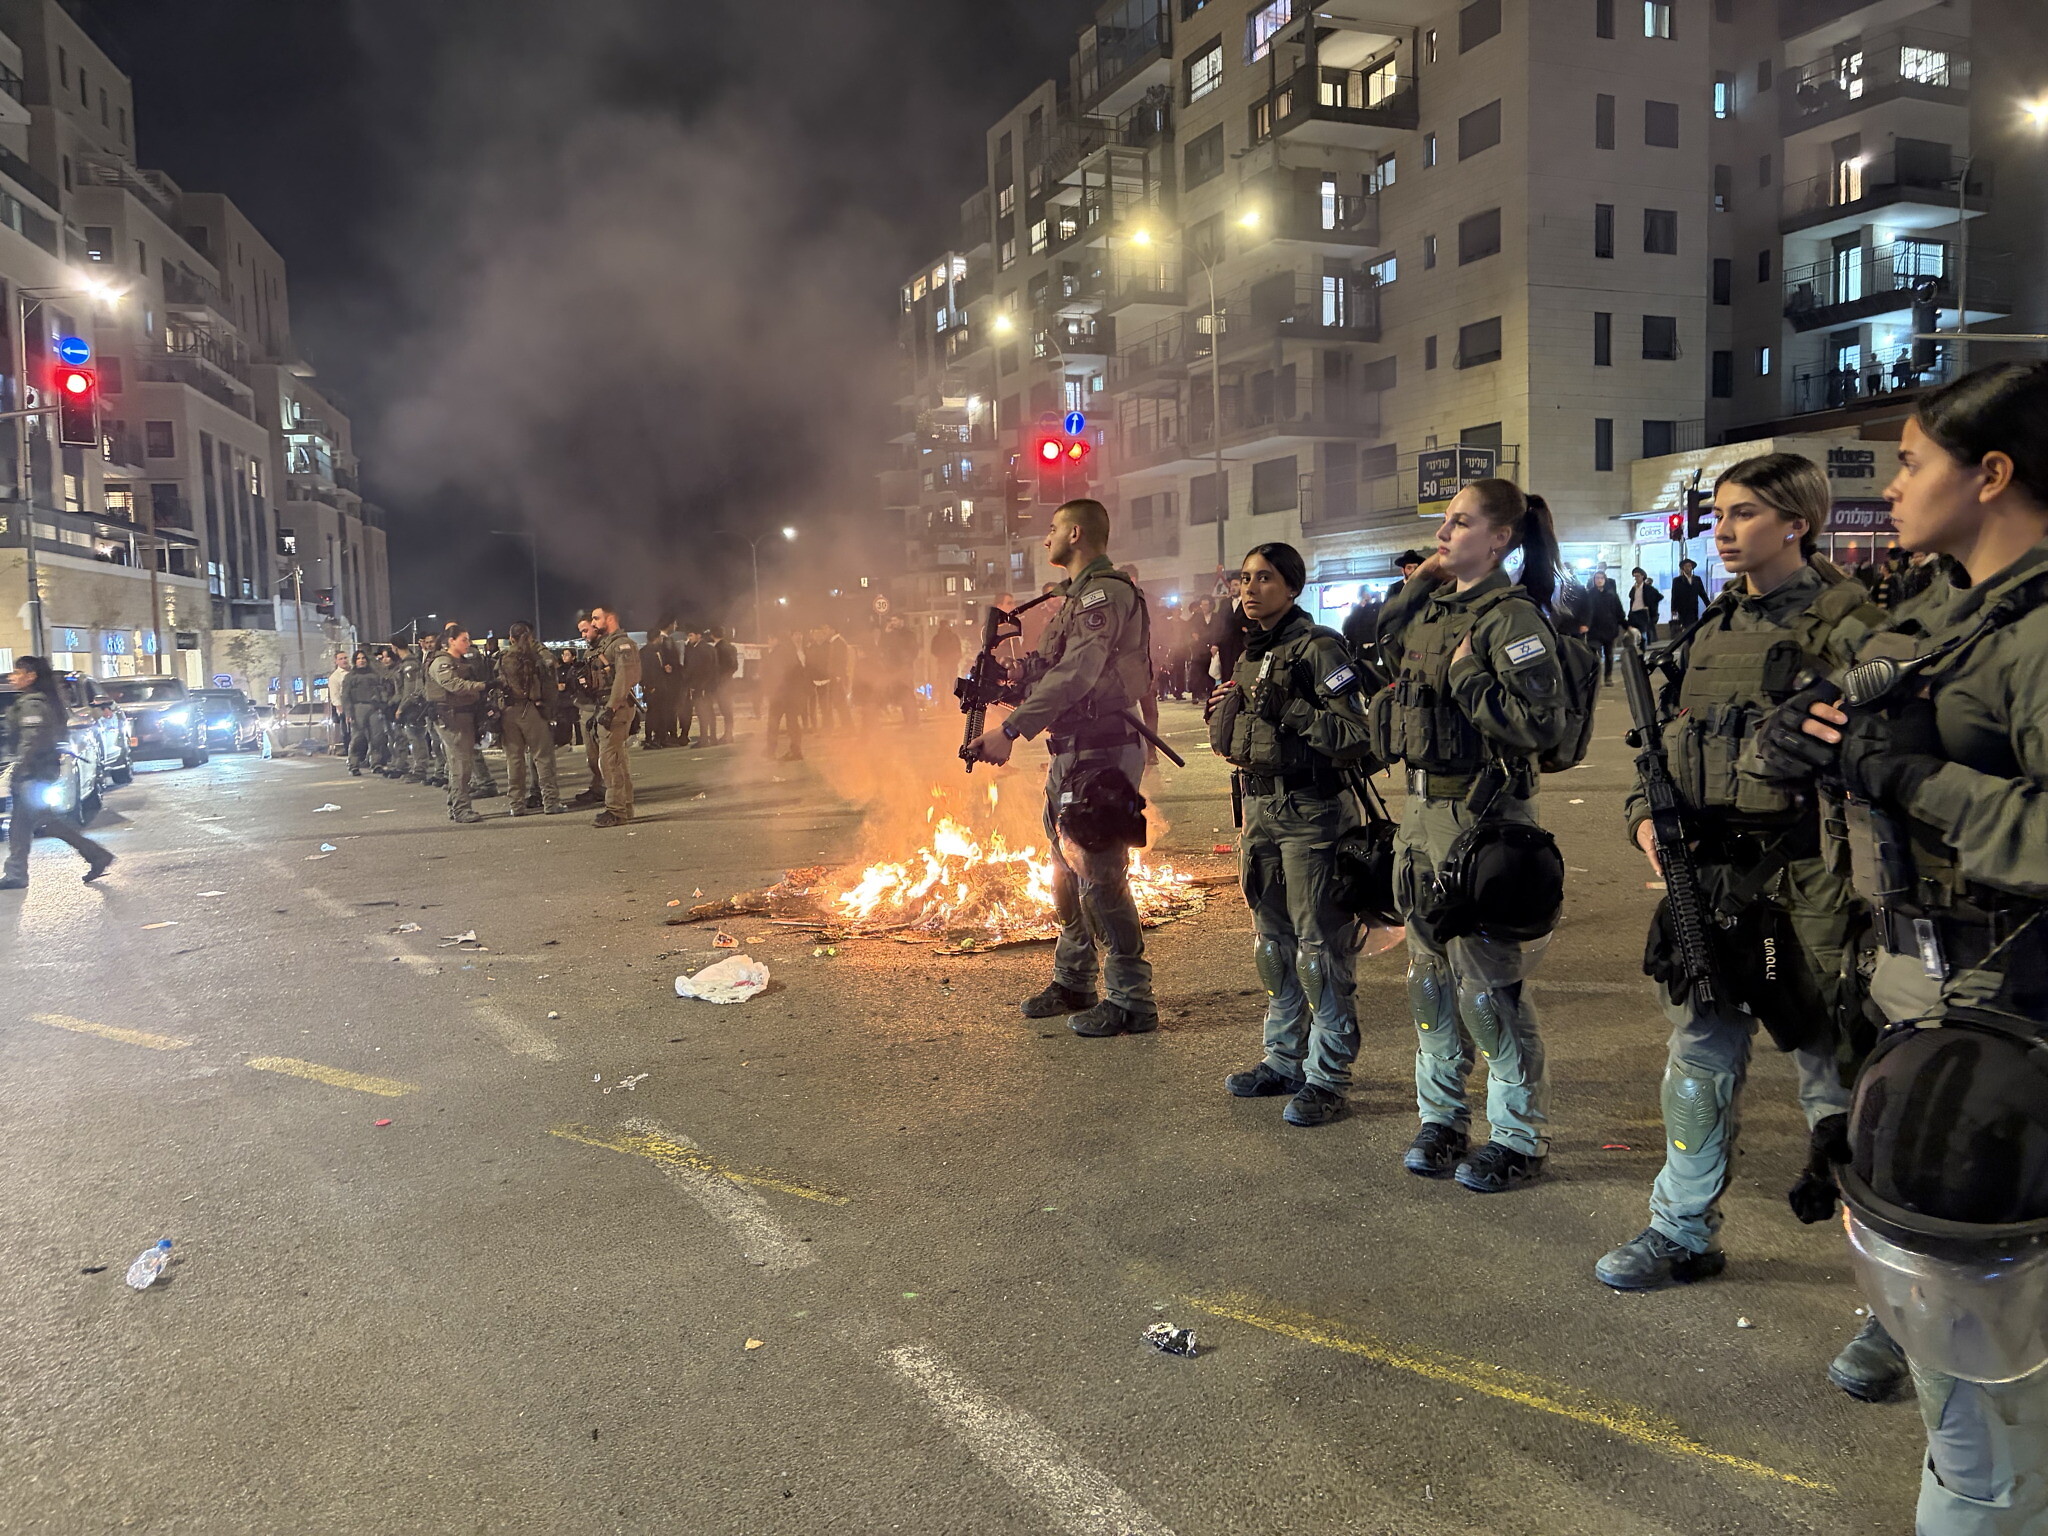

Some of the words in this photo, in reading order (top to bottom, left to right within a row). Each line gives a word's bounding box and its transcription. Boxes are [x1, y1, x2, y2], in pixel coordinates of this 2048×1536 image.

[1835, 507, 1873, 527] קולורס
[1640, 526, 1662, 537] Colors
[877, 601, 887, 610] 30
[1763, 937, 1776, 980] משטרה
